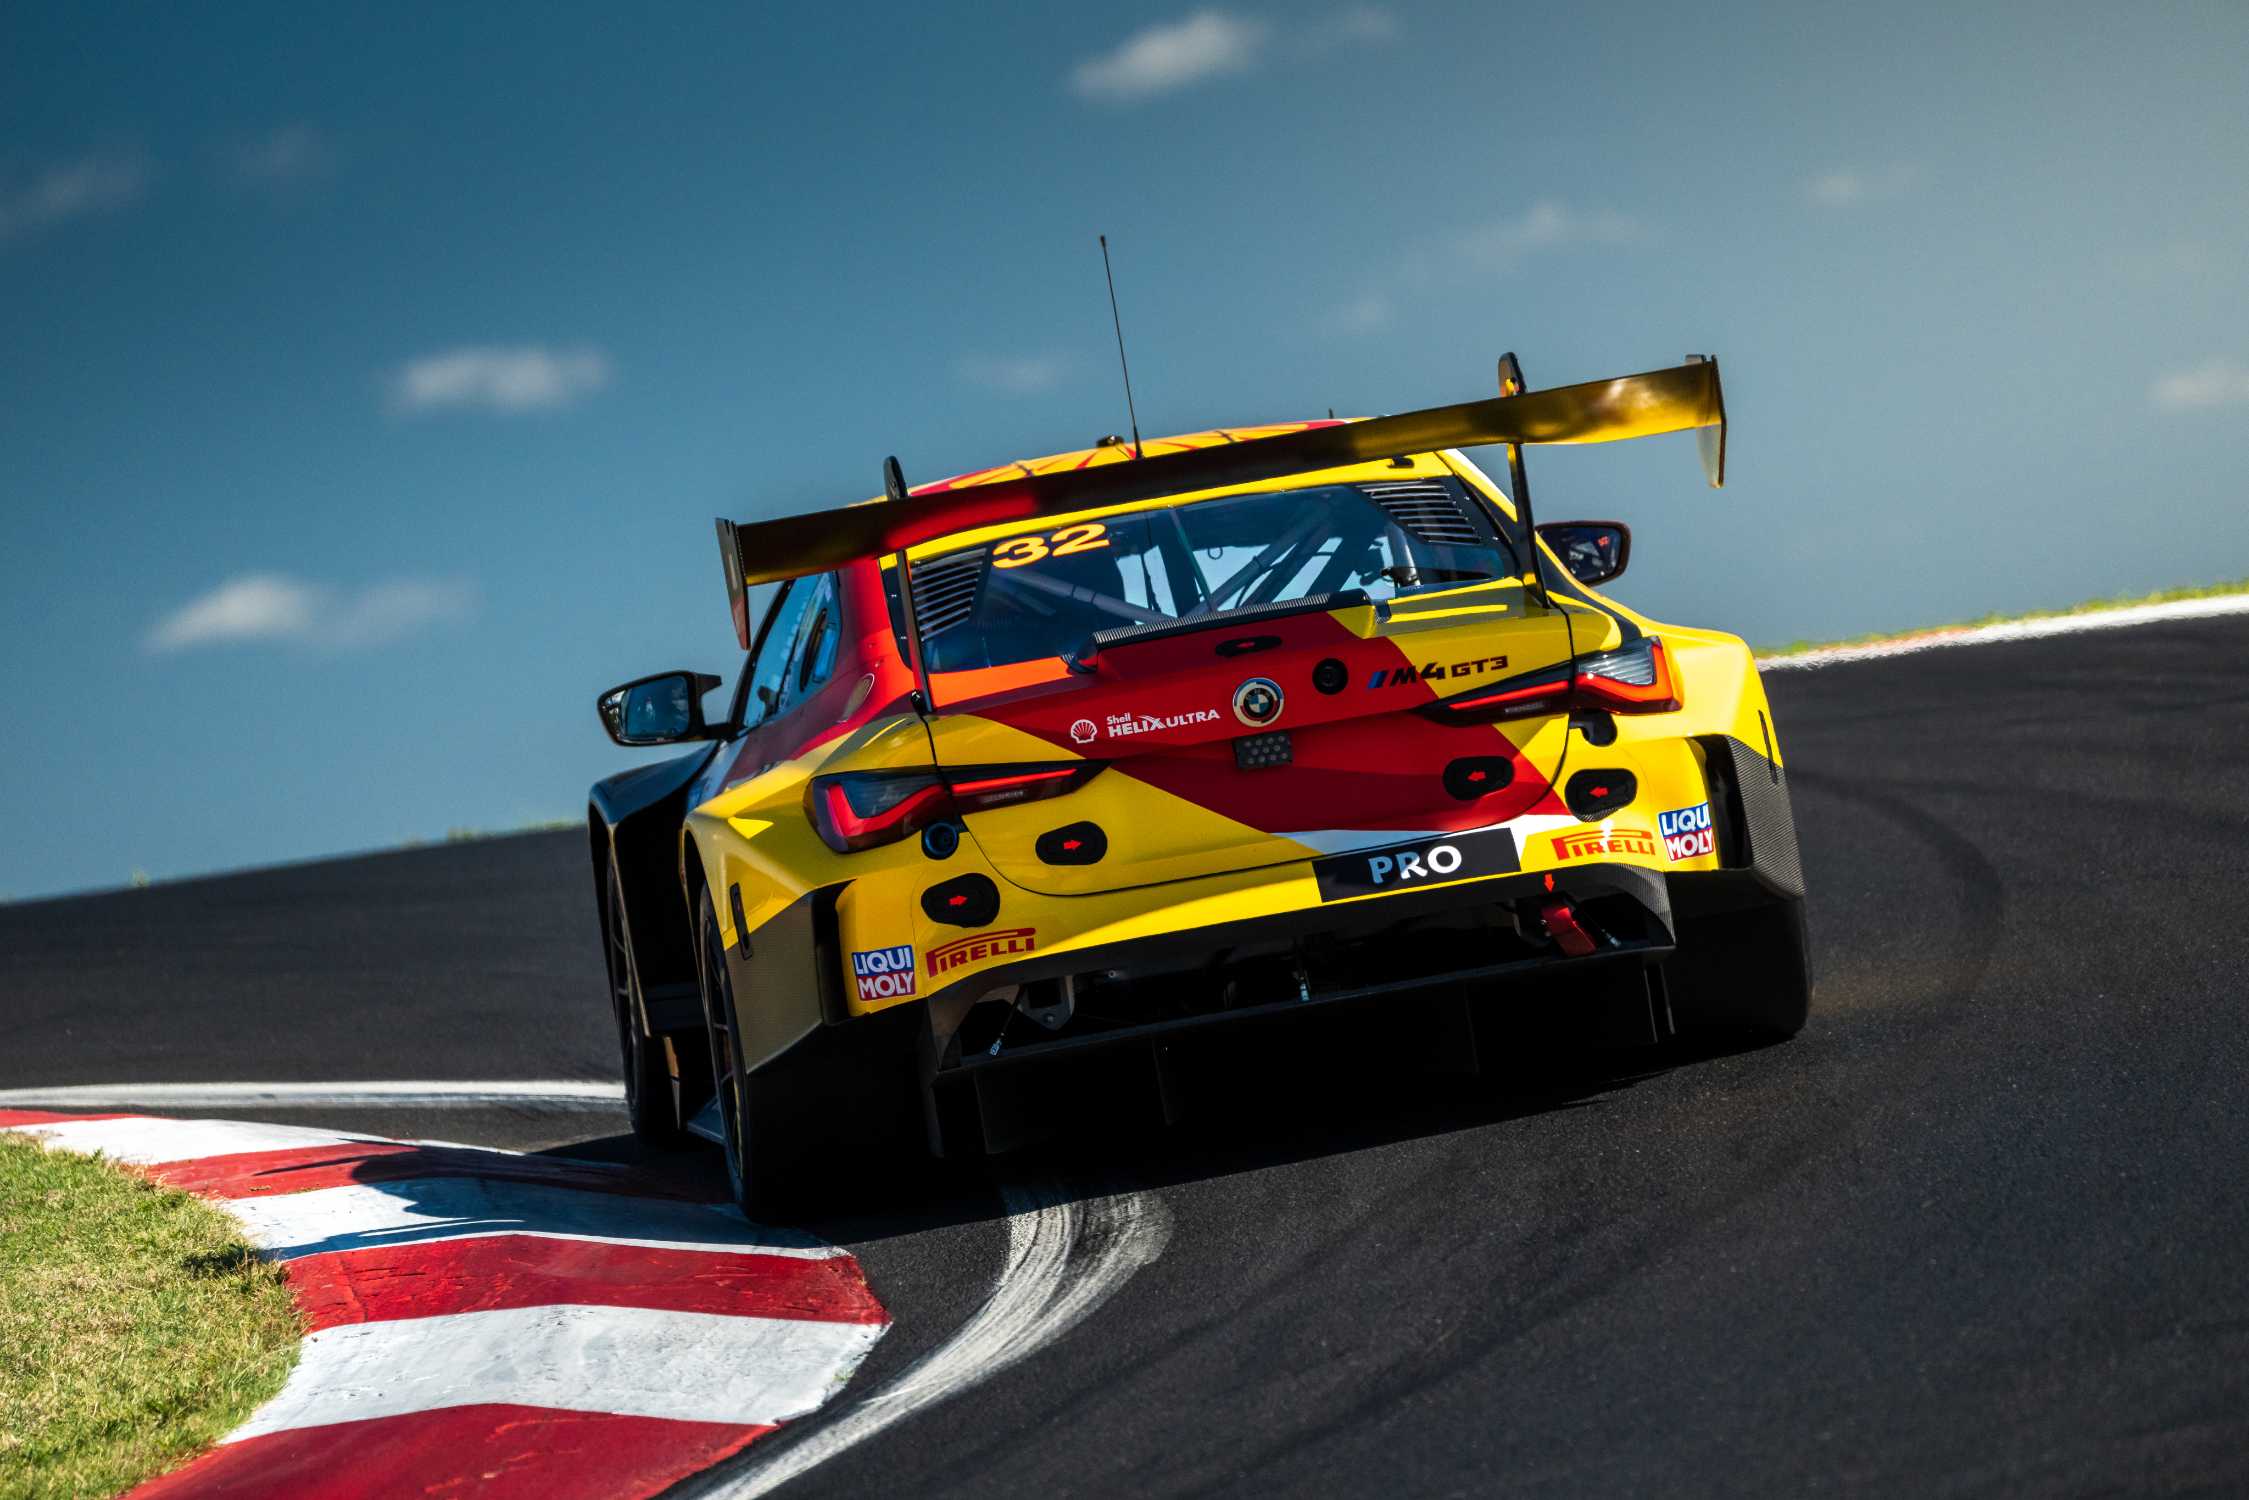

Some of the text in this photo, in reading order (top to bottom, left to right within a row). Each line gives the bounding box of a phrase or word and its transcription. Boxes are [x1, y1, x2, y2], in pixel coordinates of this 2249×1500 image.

[992, 524, 1110, 569] 32
[1451, 655, 1509, 678] GT3
[1106, 712, 1131, 725] Shell
[1107, 709, 1222, 738] HELIX ULTRA
[1551, 828, 1656, 861] PIRELLI
[1665, 828, 1713, 860] MOLY
[1368, 845, 1462, 884] PRO
[853, 946, 913, 975] LIQUI
[926, 927, 1037, 979] PIRELLI
[858, 971, 915, 999] MOLY
